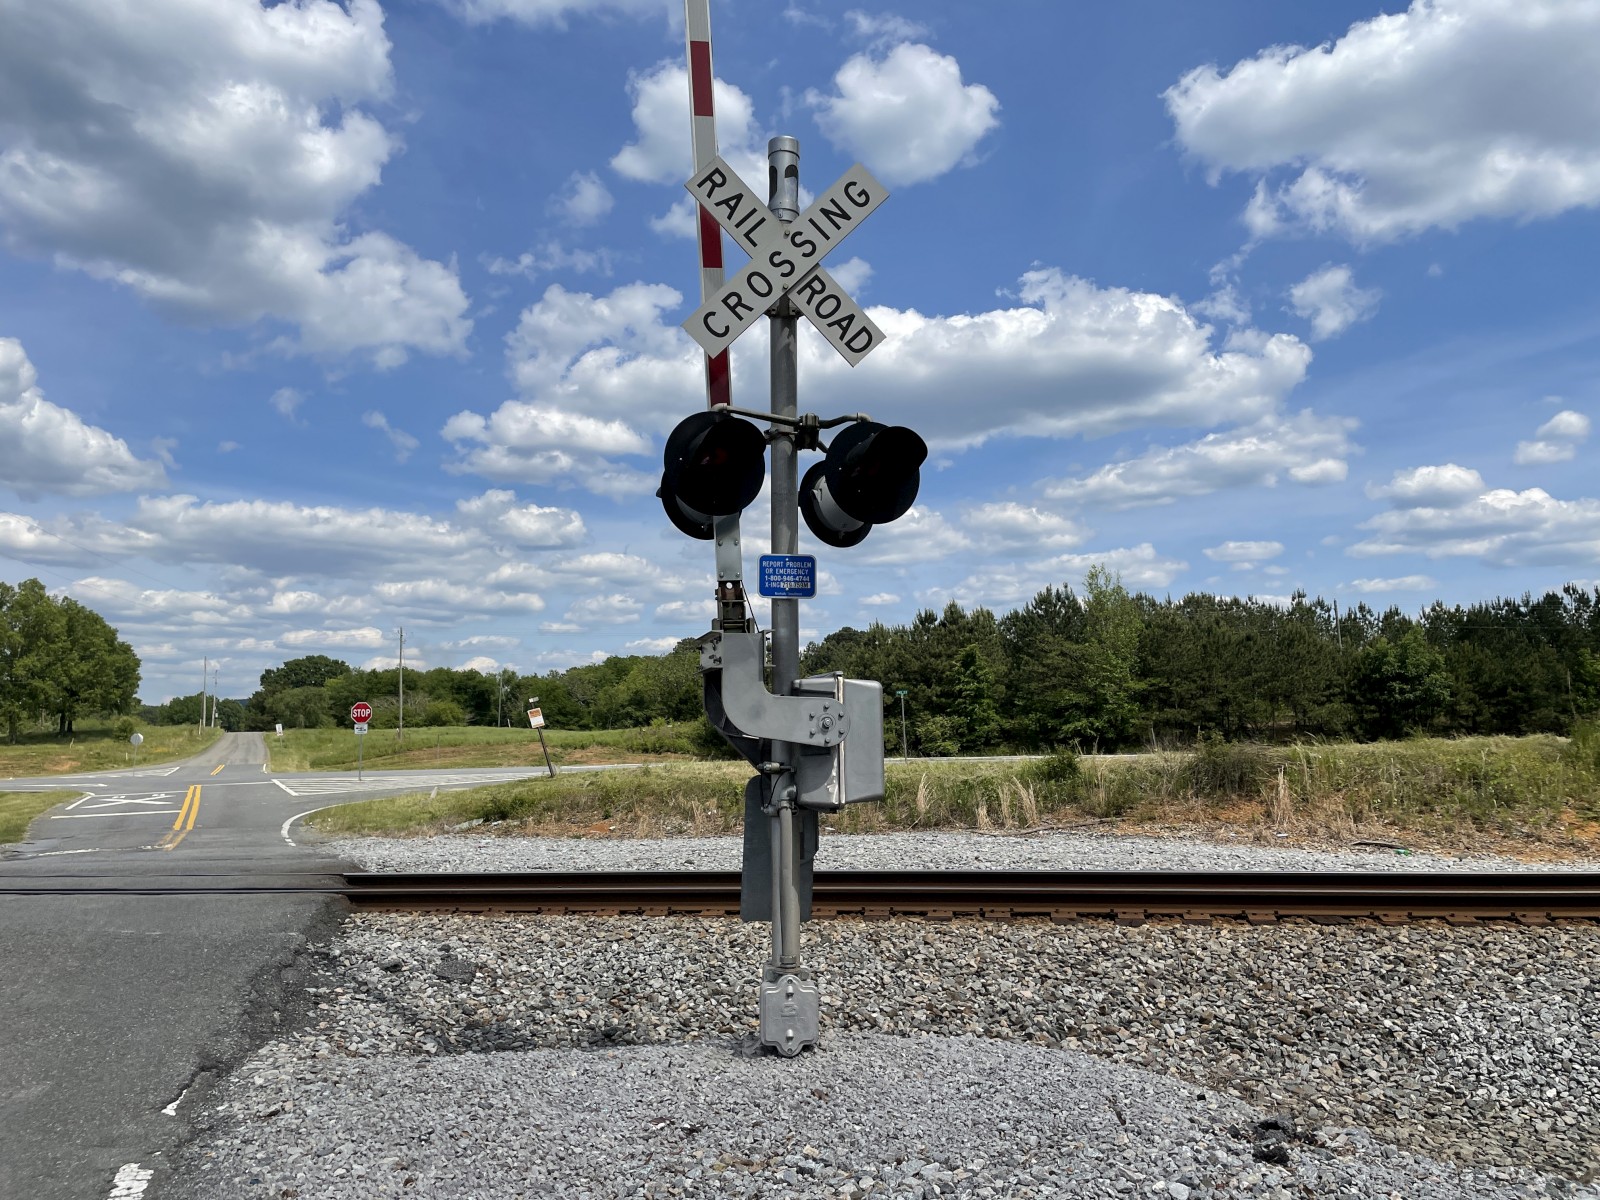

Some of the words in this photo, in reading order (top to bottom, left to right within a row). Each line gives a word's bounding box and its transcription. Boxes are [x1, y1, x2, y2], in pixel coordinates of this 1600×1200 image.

[696, 167, 767, 248] RAIL
[796, 274, 873, 354] ROAD
[702, 181, 871, 338] CROSSING
[352, 709, 371, 718] STOP
